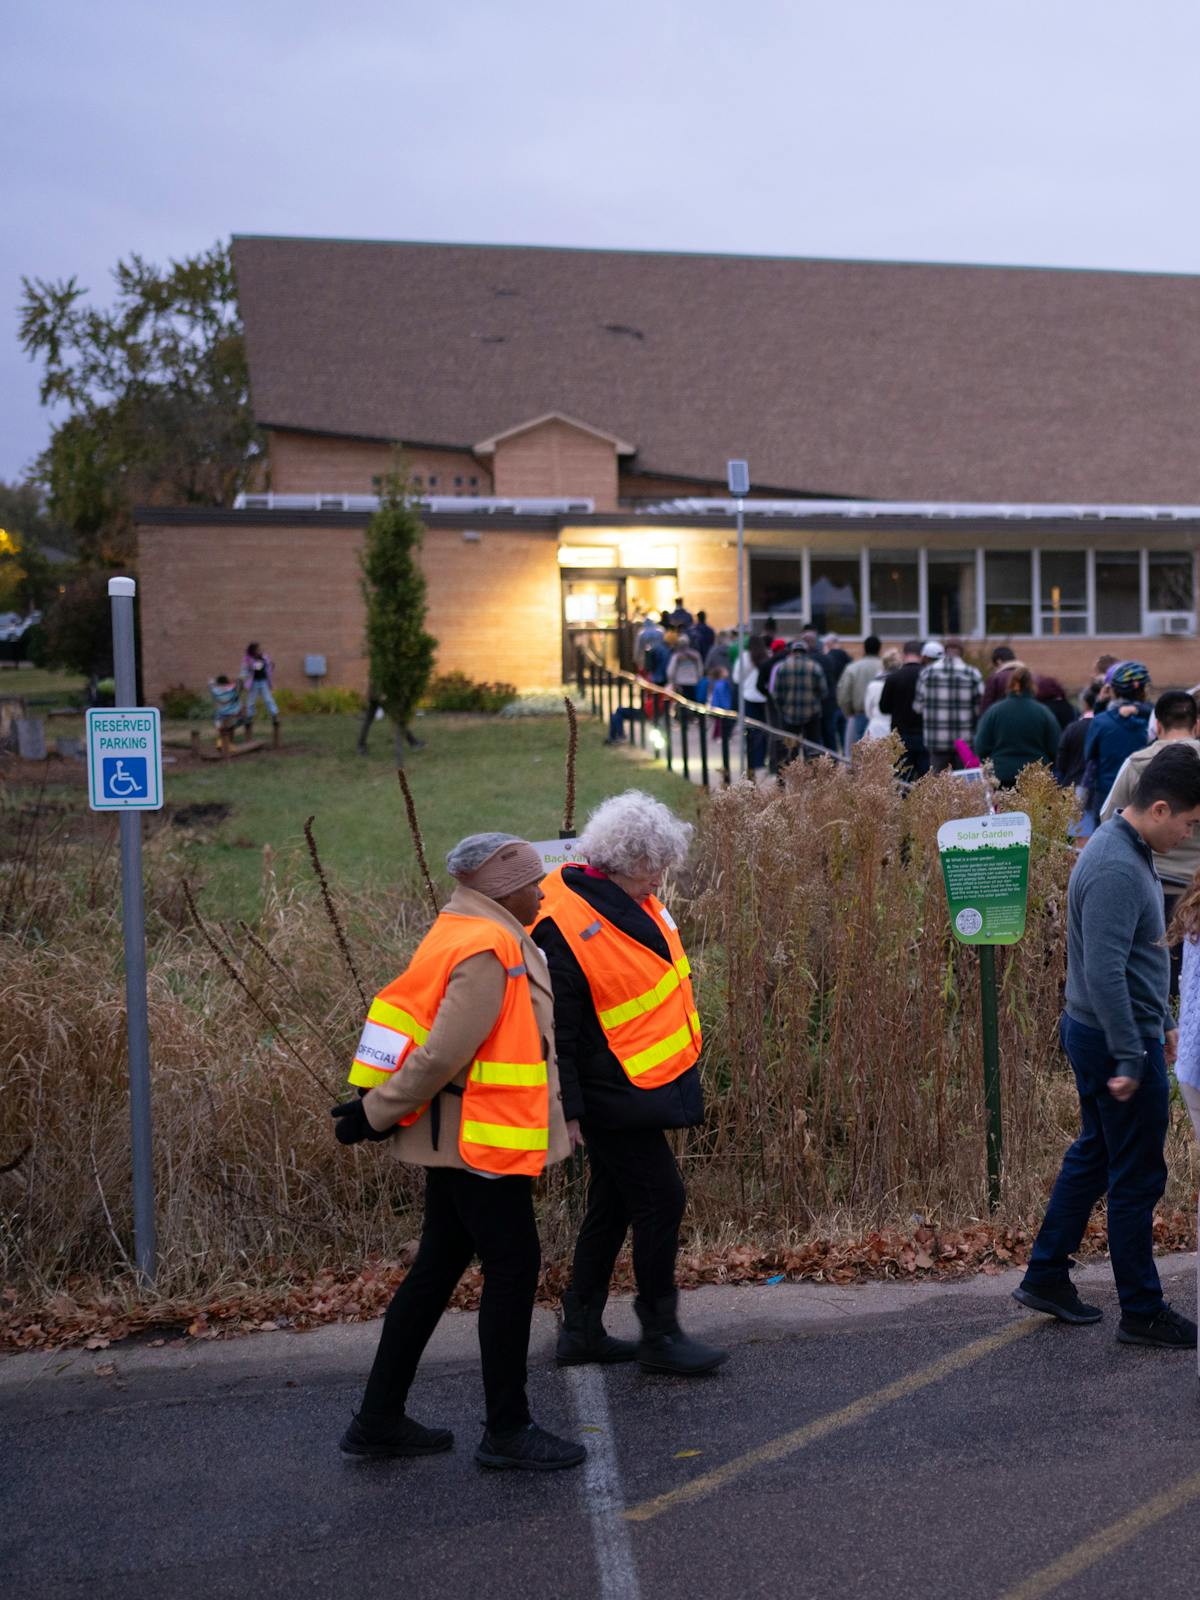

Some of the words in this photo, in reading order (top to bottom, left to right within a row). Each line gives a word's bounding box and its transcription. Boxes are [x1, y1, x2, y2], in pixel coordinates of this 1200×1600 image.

[94, 720, 151, 732] RESERVED
[100, 737, 147, 749] PARKING
[957, 831, 980, 840] Solar
[981, 830, 1014, 839] Garden
[544, 854, 568, 863] Back
